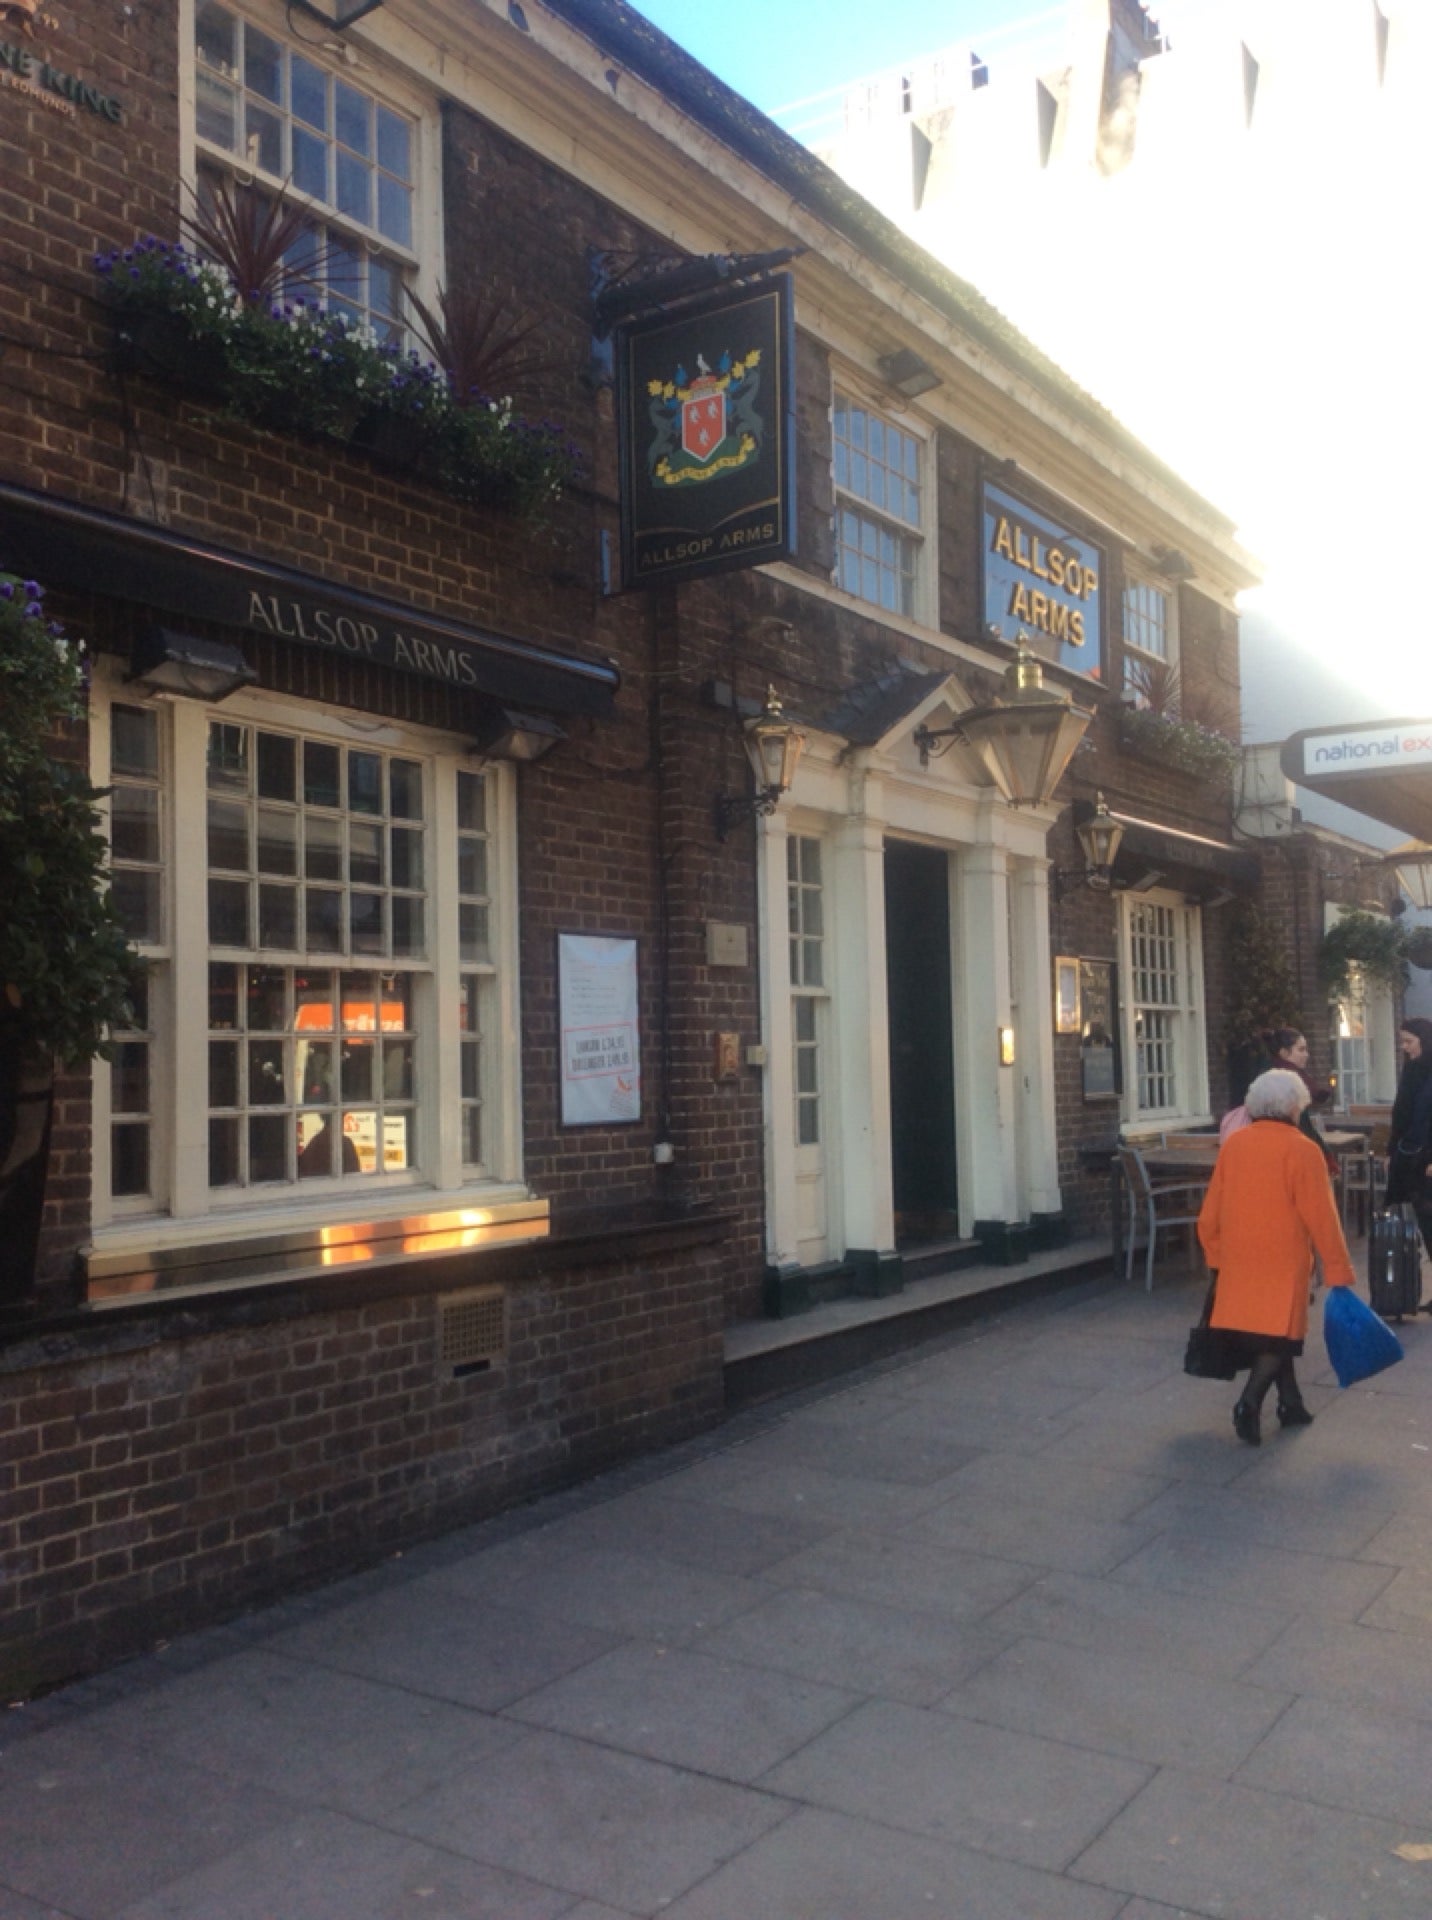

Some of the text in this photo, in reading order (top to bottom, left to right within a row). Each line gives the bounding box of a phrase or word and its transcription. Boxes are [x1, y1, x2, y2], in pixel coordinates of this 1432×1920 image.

[38, 63, 122, 123] KING
[641, 523, 774, 566] ALLSOP ARMS
[991, 516, 1098, 648] ALLSOP ARMS
[249, 590, 478, 685] ALLSOP ARMS
[1315, 735, 1399, 763] national
